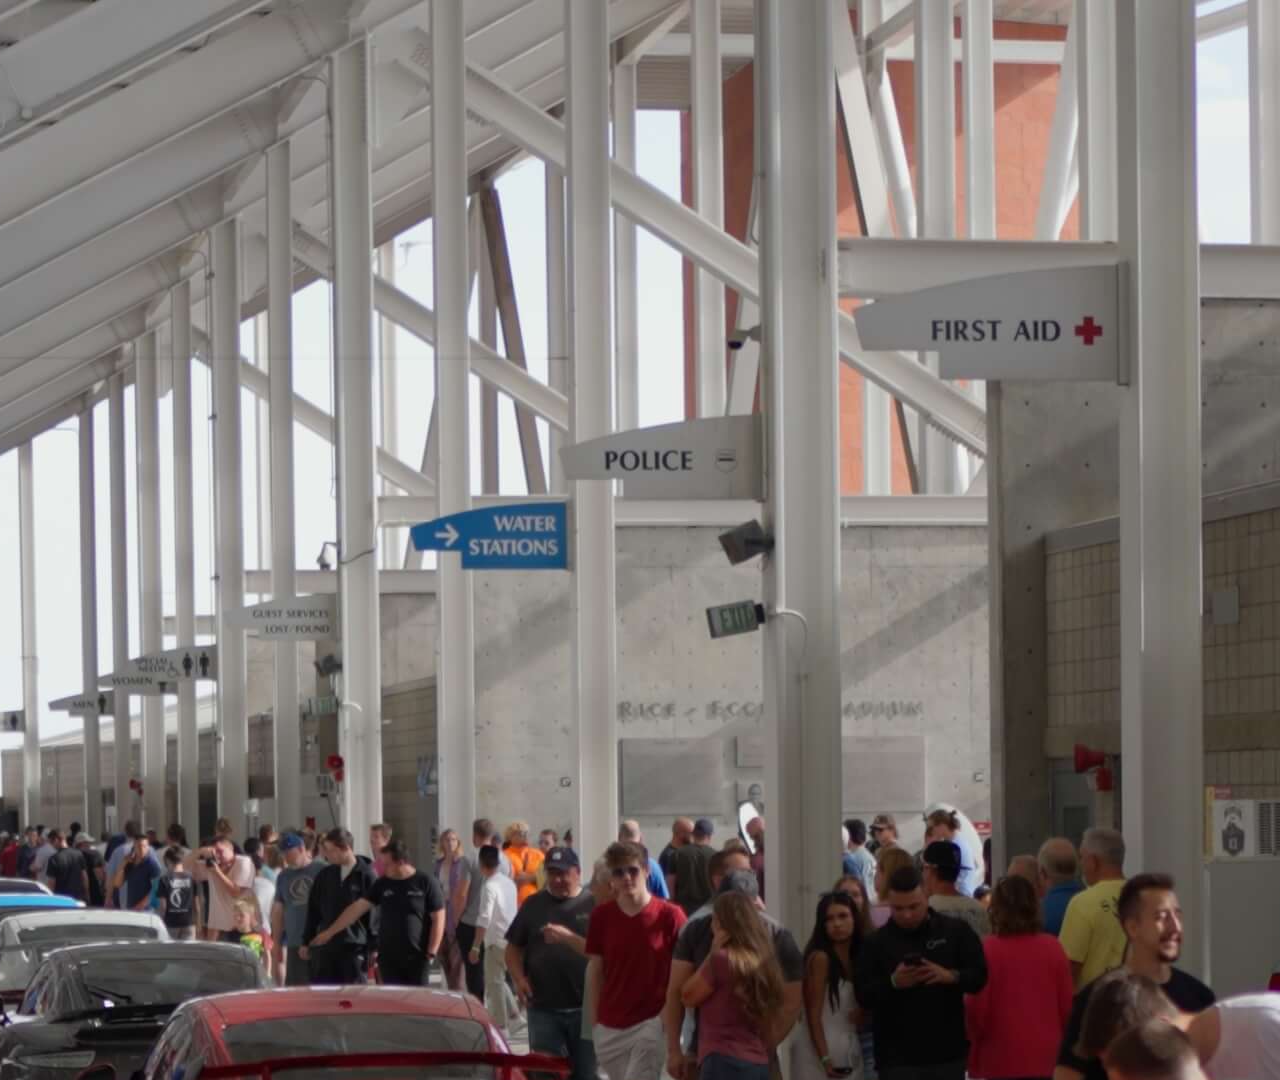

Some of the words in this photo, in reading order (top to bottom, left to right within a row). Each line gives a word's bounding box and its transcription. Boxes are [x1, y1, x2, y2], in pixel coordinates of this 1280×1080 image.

[930, 319, 999, 343] FIRST
[1013, 319, 1062, 343] AID
[604, 450, 694, 472] POLICE
[493, 515, 557, 533] WATER
[469, 538, 558, 557] STATIONS
[251, 608, 283, 619] GUEST
[286, 608, 330, 619] SERVICES
[112, 676, 153, 686] WOMEN
[72, 701, 95, 709] MEN
